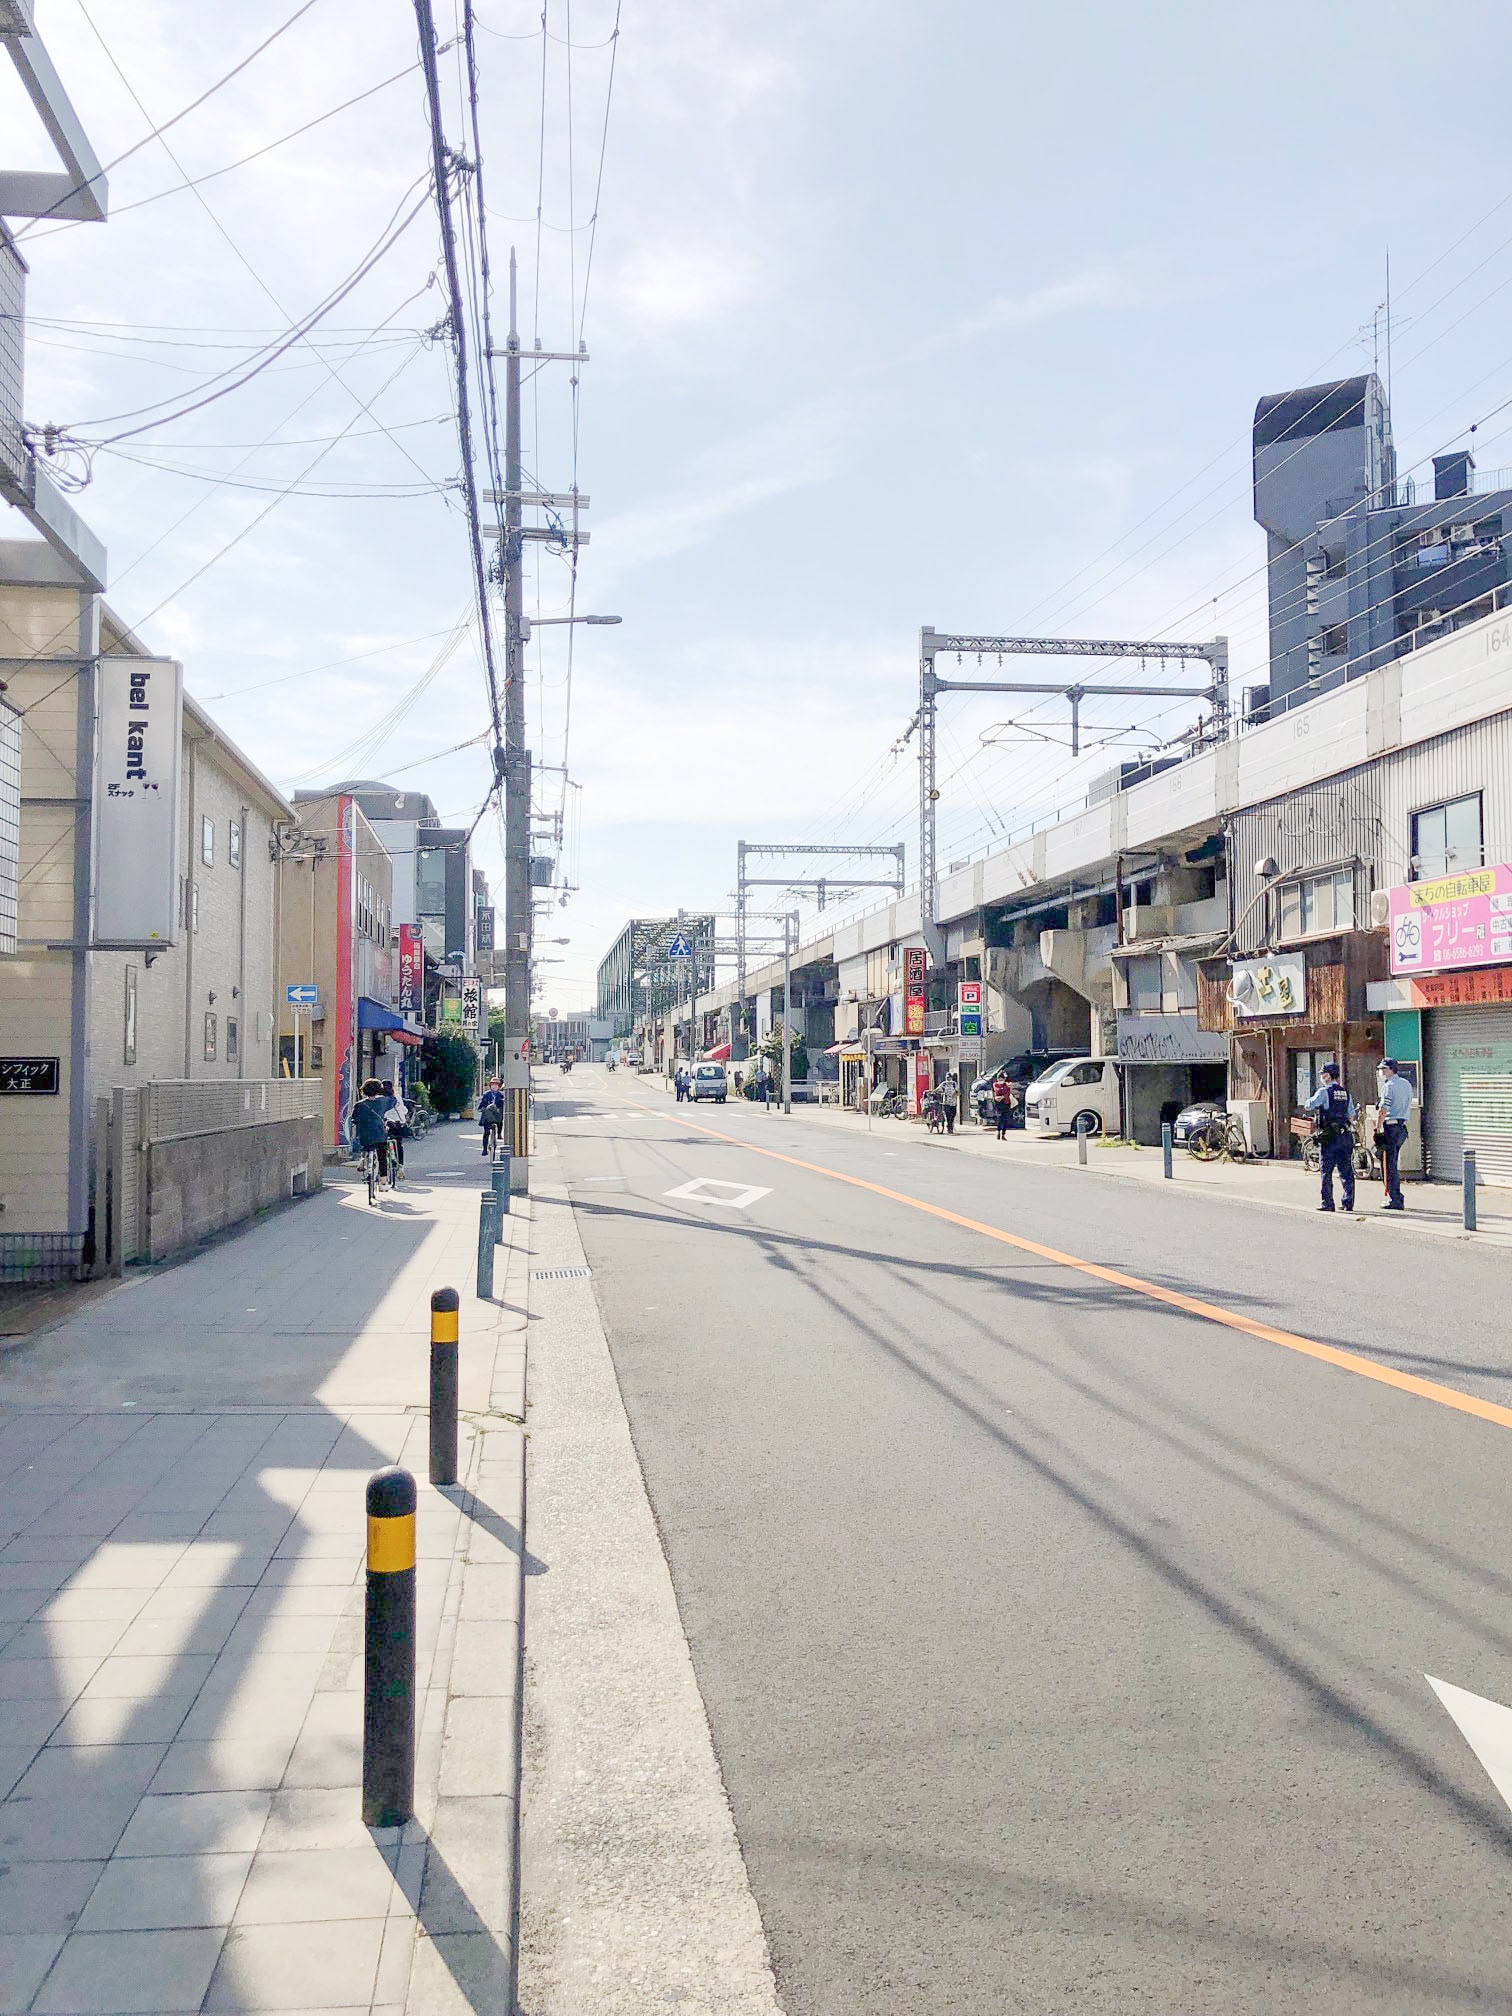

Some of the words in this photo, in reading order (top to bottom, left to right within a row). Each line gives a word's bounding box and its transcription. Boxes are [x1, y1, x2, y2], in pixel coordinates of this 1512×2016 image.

[1486, 623, 1511, 657] 164
[129, 672, 151, 710] bel
[1293, 715, 1310, 741] 165
[126, 721, 149, 780] kant
[107, 790, 135, 798] スナック
[1414, 874, 1491, 904] まちの自転車屋
[1432, 921, 1475, 947] フリー
[909, 951, 923, 997] 居酒屋
[463, 987, 478, 1020] 旅館
[2, 1064, 49, 1076] シフィック
[7, 1078, 32, 1089] 大正
